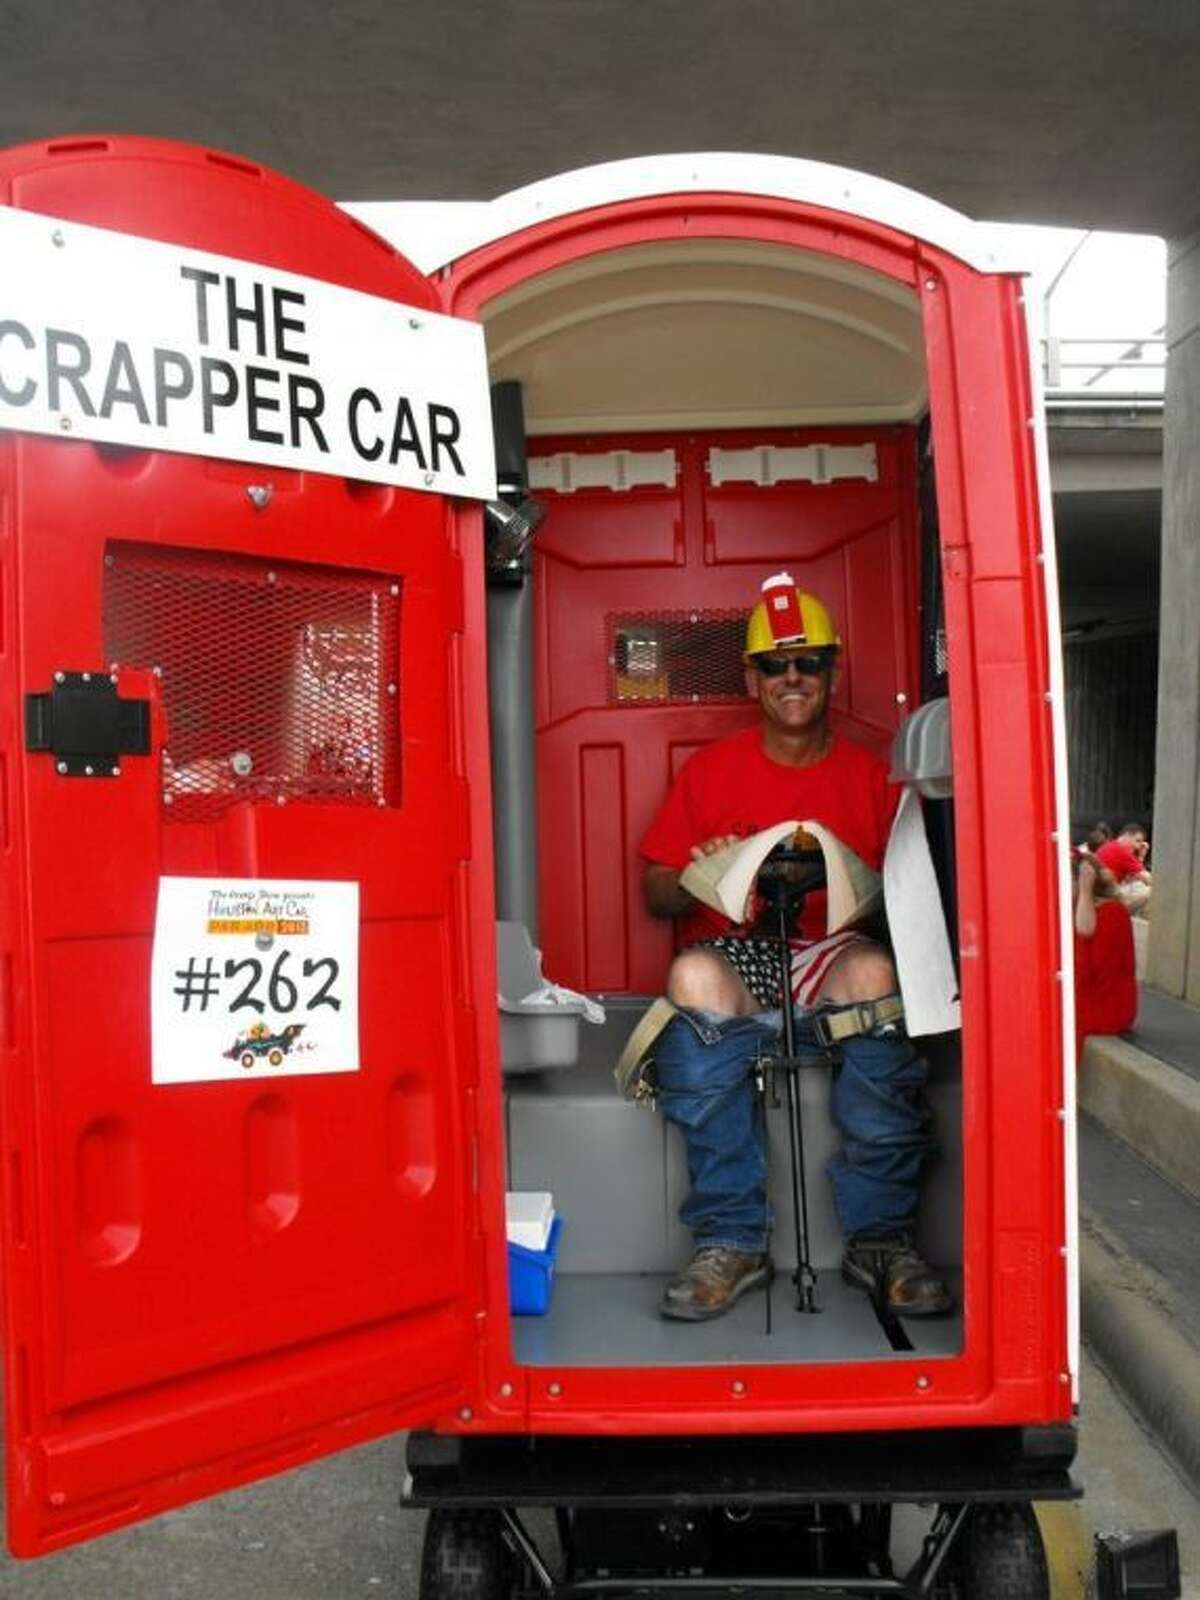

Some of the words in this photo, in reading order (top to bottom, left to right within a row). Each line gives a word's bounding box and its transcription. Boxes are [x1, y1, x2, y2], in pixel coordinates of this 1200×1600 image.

[180, 265, 310, 366] THE
[0, 319, 331, 454] CRAPPER
[347, 386, 466, 477] CAR
[173, 949, 342, 1014] #262
